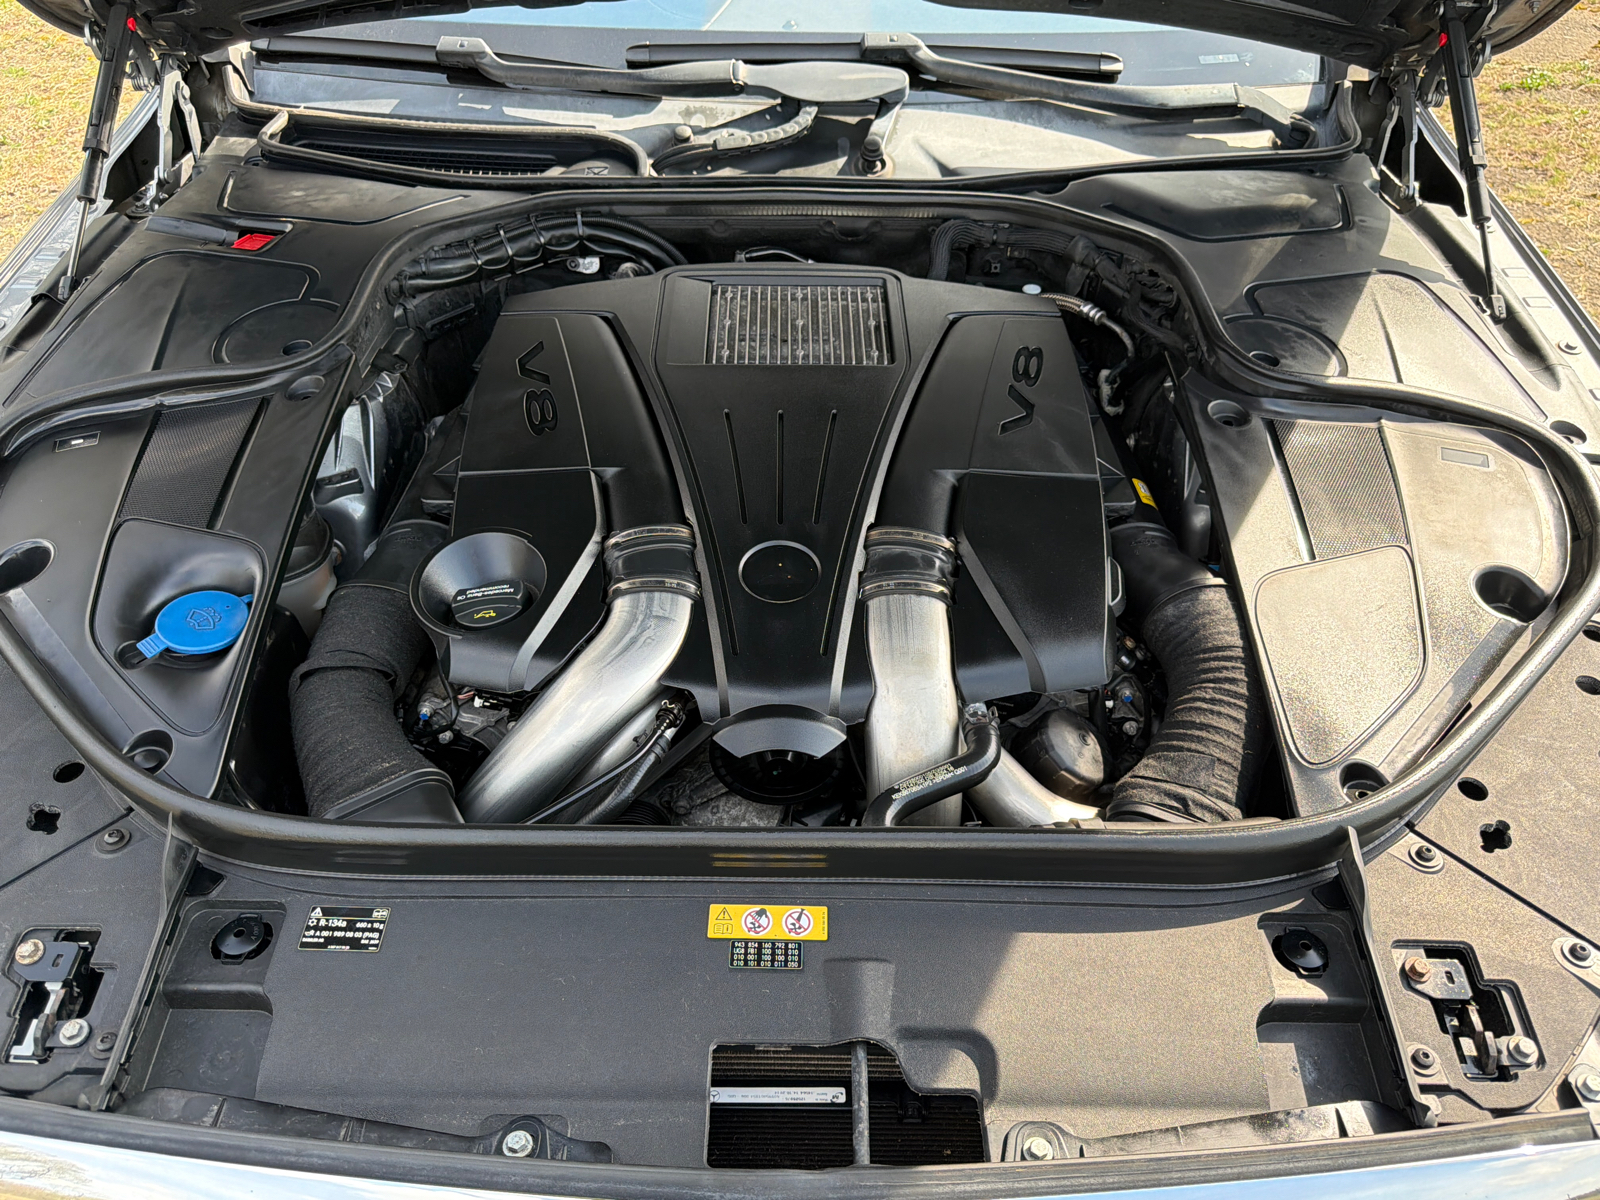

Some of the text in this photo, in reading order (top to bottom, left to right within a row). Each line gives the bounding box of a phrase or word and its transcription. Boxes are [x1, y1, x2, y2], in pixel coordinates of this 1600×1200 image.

[516, 339, 558, 436] V8
[998, 345, 1043, 435] V8
[466, 584, 510, 594] recommended
[466, 588, 514, 598] Mercedes-Benz
[319, 918, 347, 927] R-134a
